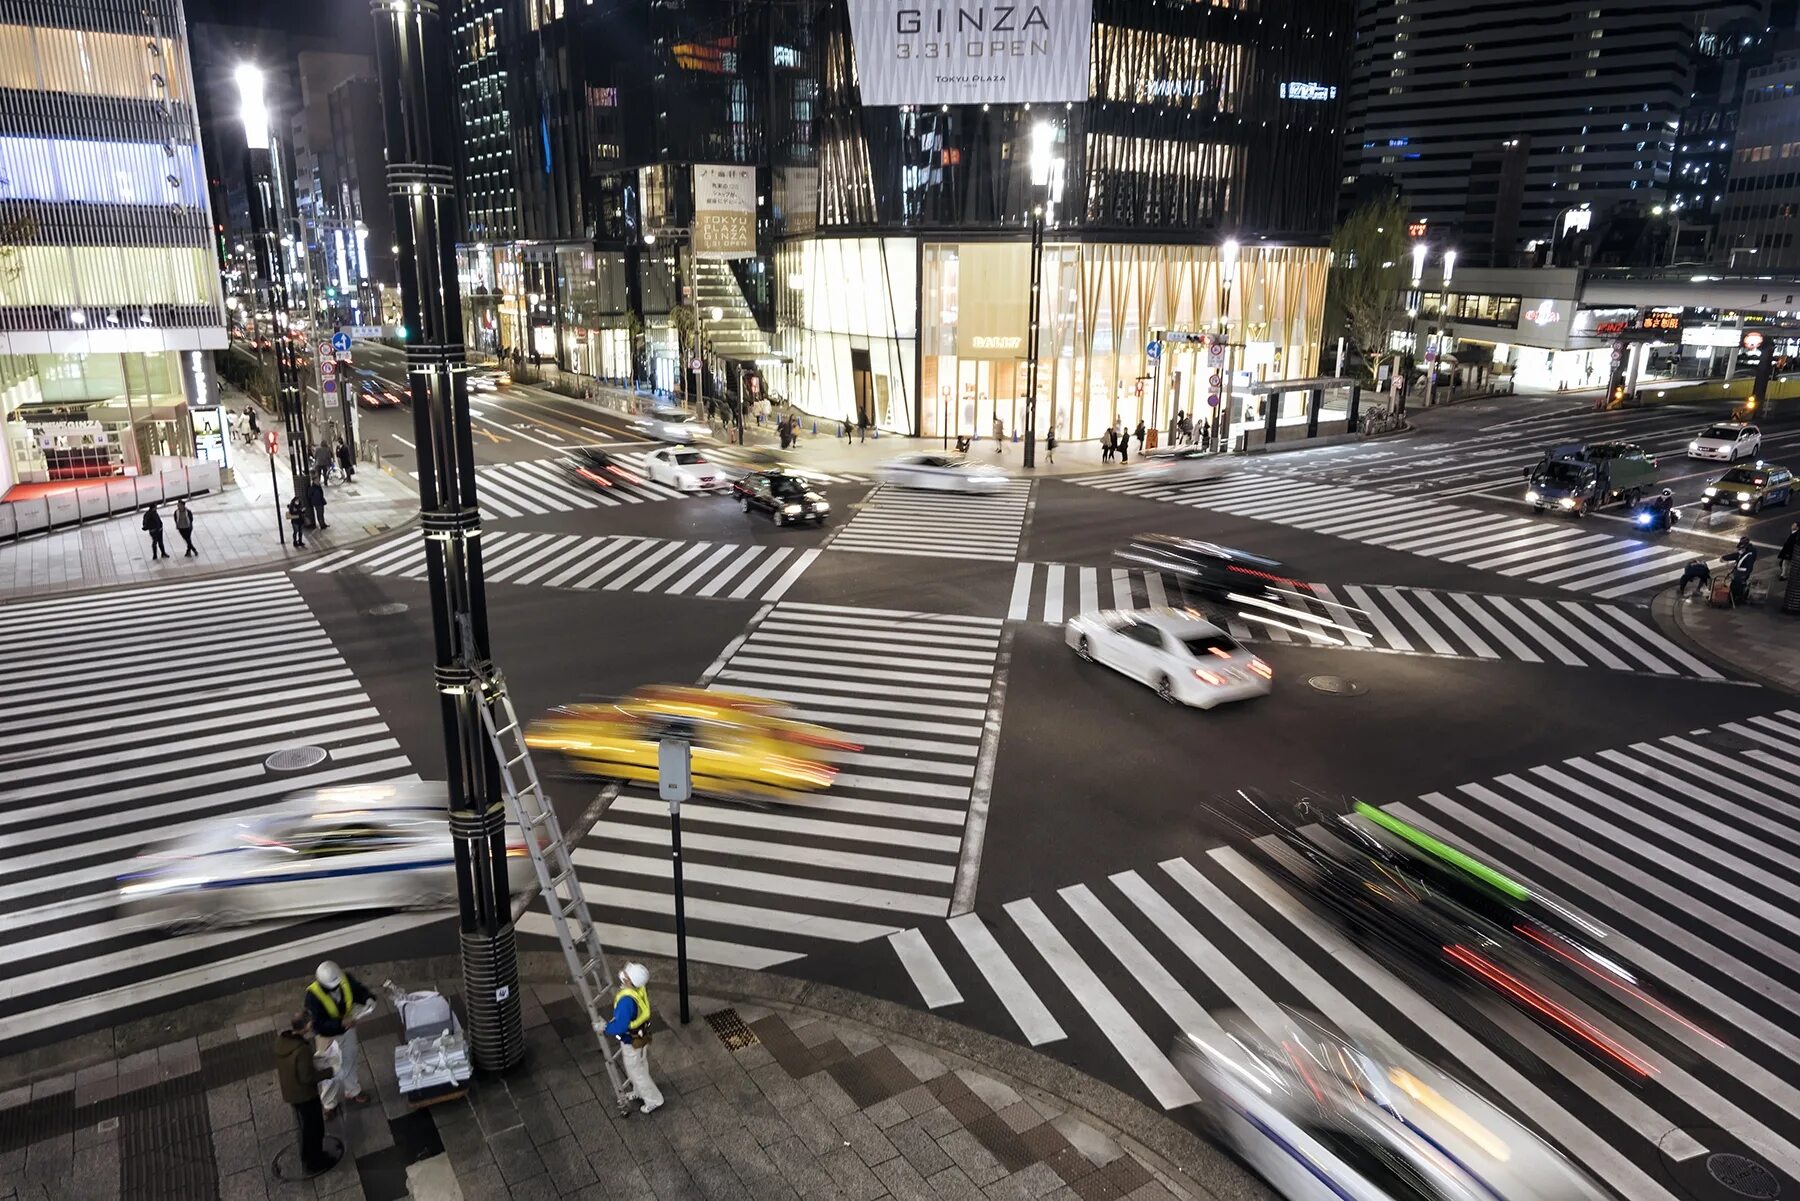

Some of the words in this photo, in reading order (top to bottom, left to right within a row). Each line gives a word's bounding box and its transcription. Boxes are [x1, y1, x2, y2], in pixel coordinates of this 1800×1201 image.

[897, 5, 1050, 34] GINZA
[897, 42, 951, 60] 3.31
[966, 40, 1048, 58] OPEN
[935, 75, 969, 83] TOKYU
[972, 74, 1007, 83] PLAZA
[704, 216, 747, 224] TOKYU
[704, 224, 747, 233] PLAZA
[704, 232, 747, 240] GINZA
